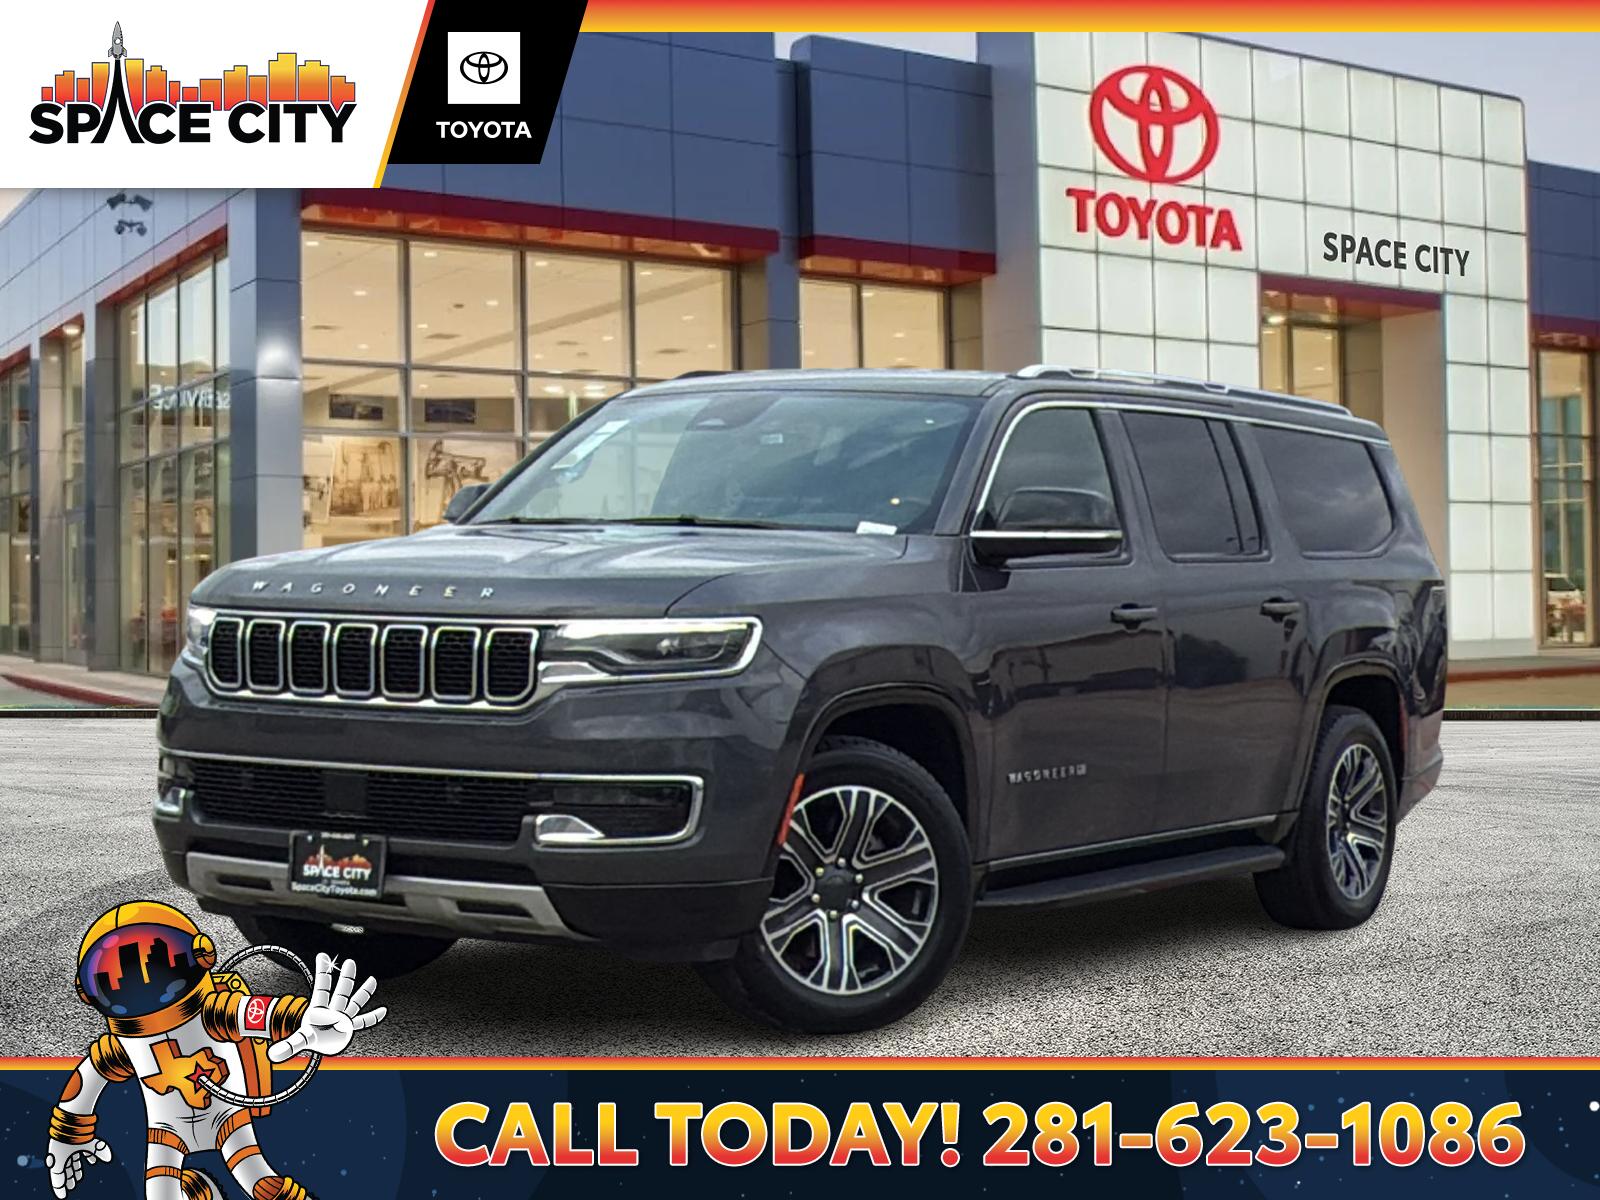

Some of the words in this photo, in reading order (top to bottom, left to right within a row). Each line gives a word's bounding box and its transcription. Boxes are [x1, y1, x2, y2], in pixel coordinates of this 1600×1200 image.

[1066, 187, 1242, 251] TOYOTA
[1323, 232, 1407, 270] SPACE
[1414, 244, 1470, 277] CITY
[252, 580, 495, 598] WAGONEER
[343, 867, 372, 880] CITY
